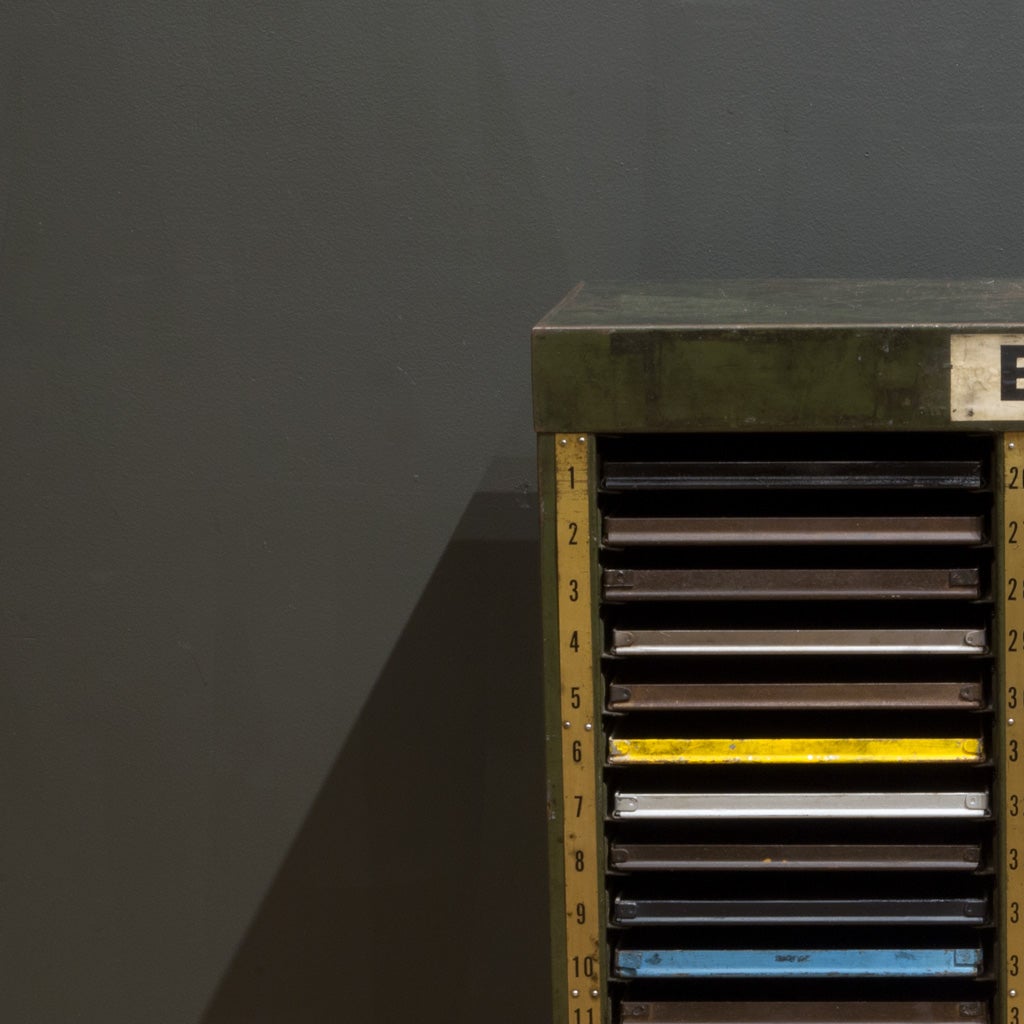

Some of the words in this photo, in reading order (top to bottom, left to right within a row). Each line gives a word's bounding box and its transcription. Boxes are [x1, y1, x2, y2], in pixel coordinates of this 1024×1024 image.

[568, 467, 575, 489] 1
[568, 522, 578, 545] 2
[569, 579, 579, 602] 3
[570, 631, 580, 653] 4
[571, 687, 581, 709] 5
[572, 741, 582, 762] 6
[574, 795, 583, 818] 7
[575, 851, 585, 872] 8
[576, 903, 586, 925] 9
[573, 956, 594, 978] 10
